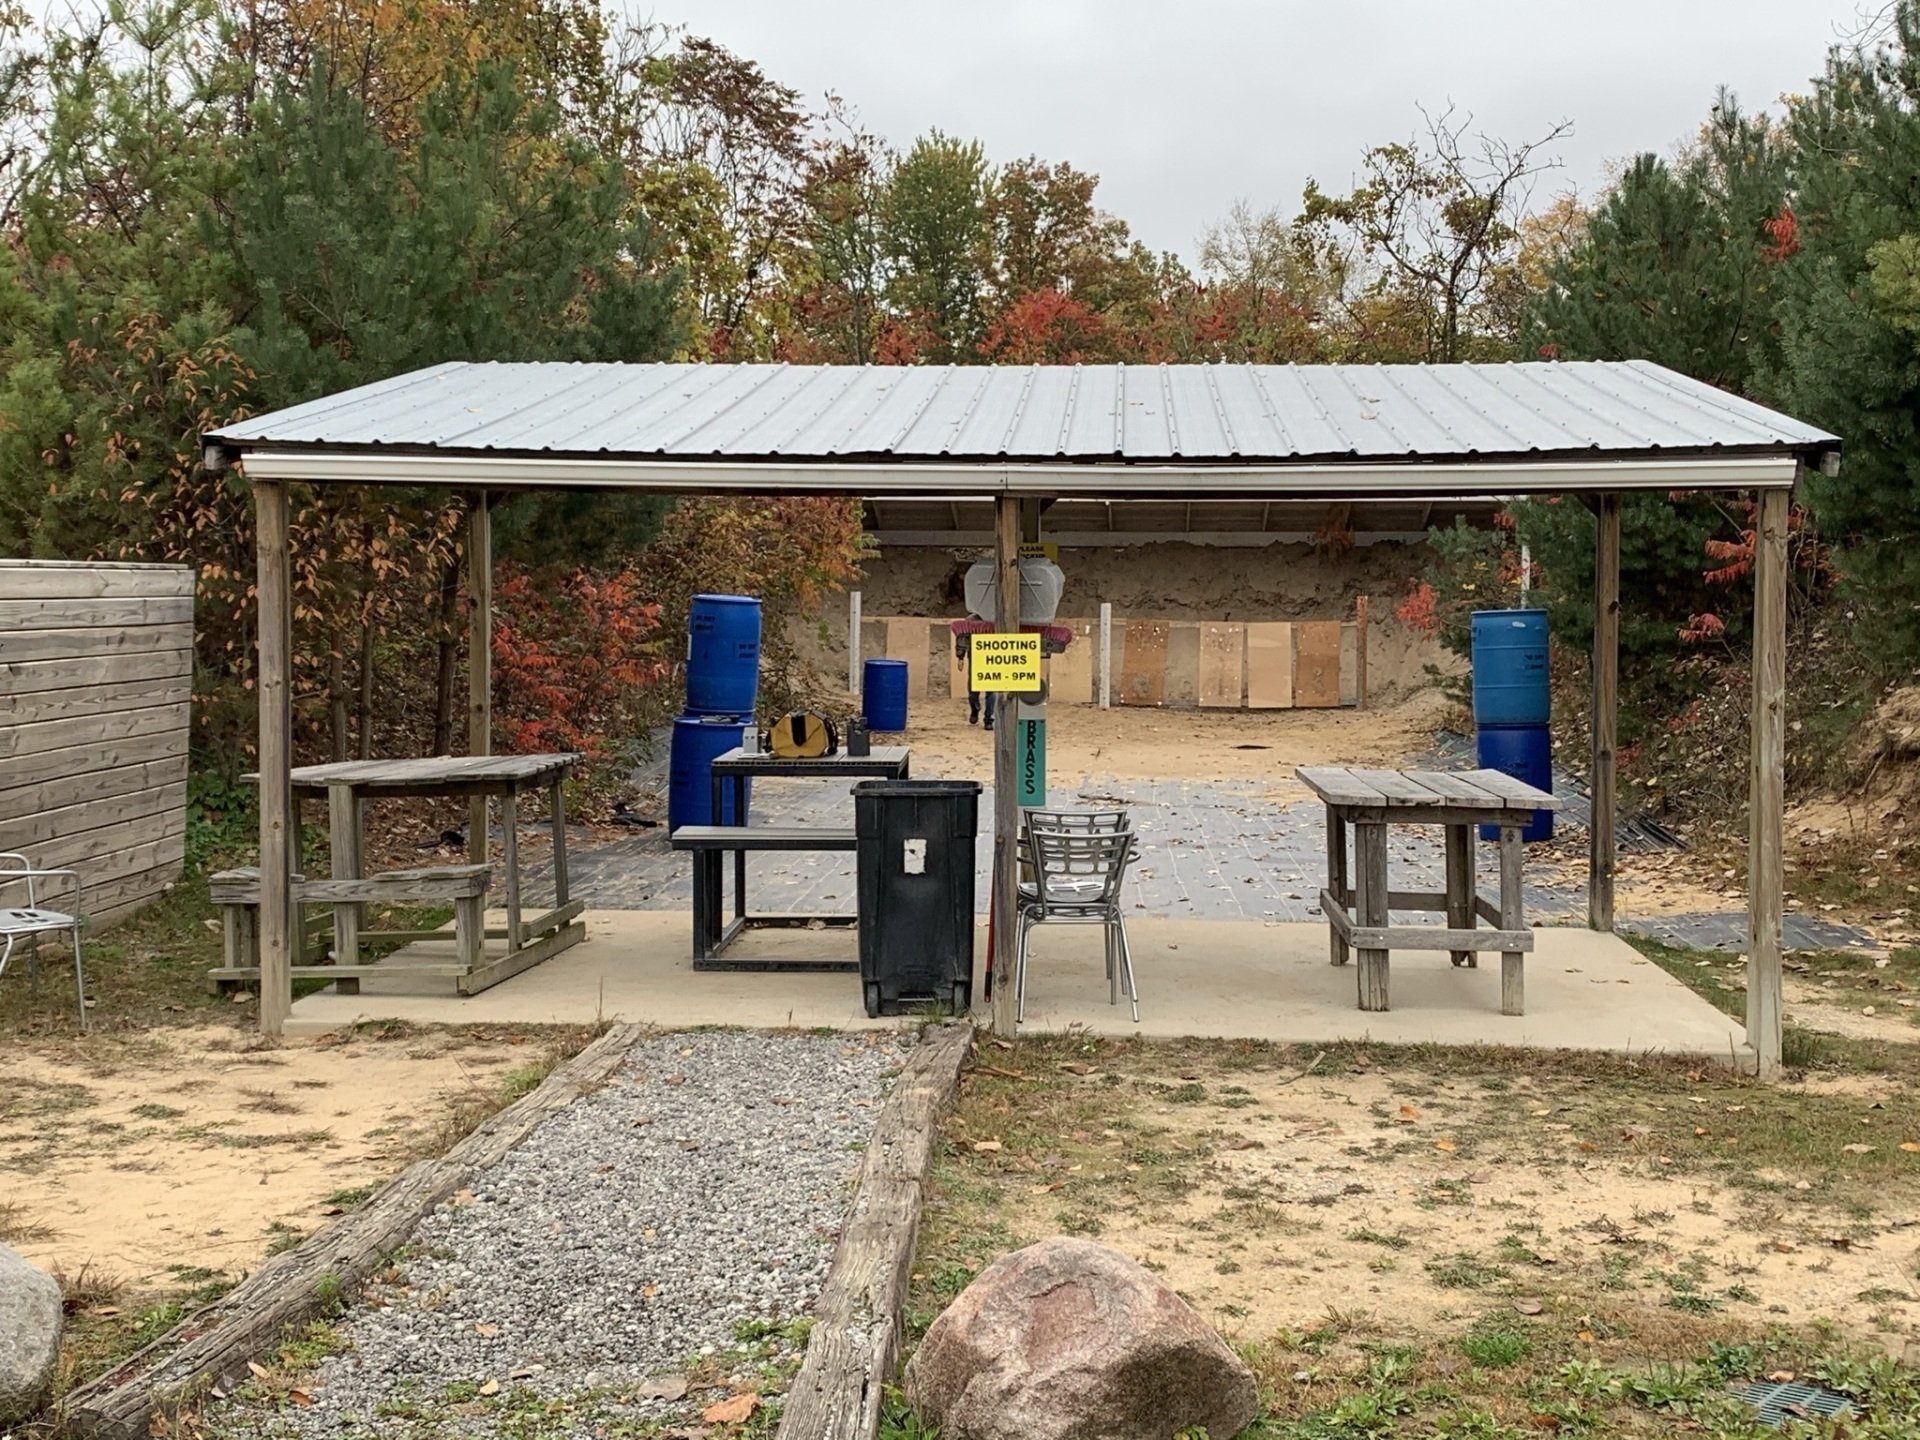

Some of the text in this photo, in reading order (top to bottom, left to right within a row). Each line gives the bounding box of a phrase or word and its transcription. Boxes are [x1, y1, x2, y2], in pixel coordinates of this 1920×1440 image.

[975, 640, 1037, 650] SHOOTING
[986, 655, 1027, 665] HOURS
[976, 672, 1002, 681] 9AM
[1011, 672, 1036, 681] 9PM
[1025, 719, 1037, 795] BRASS
